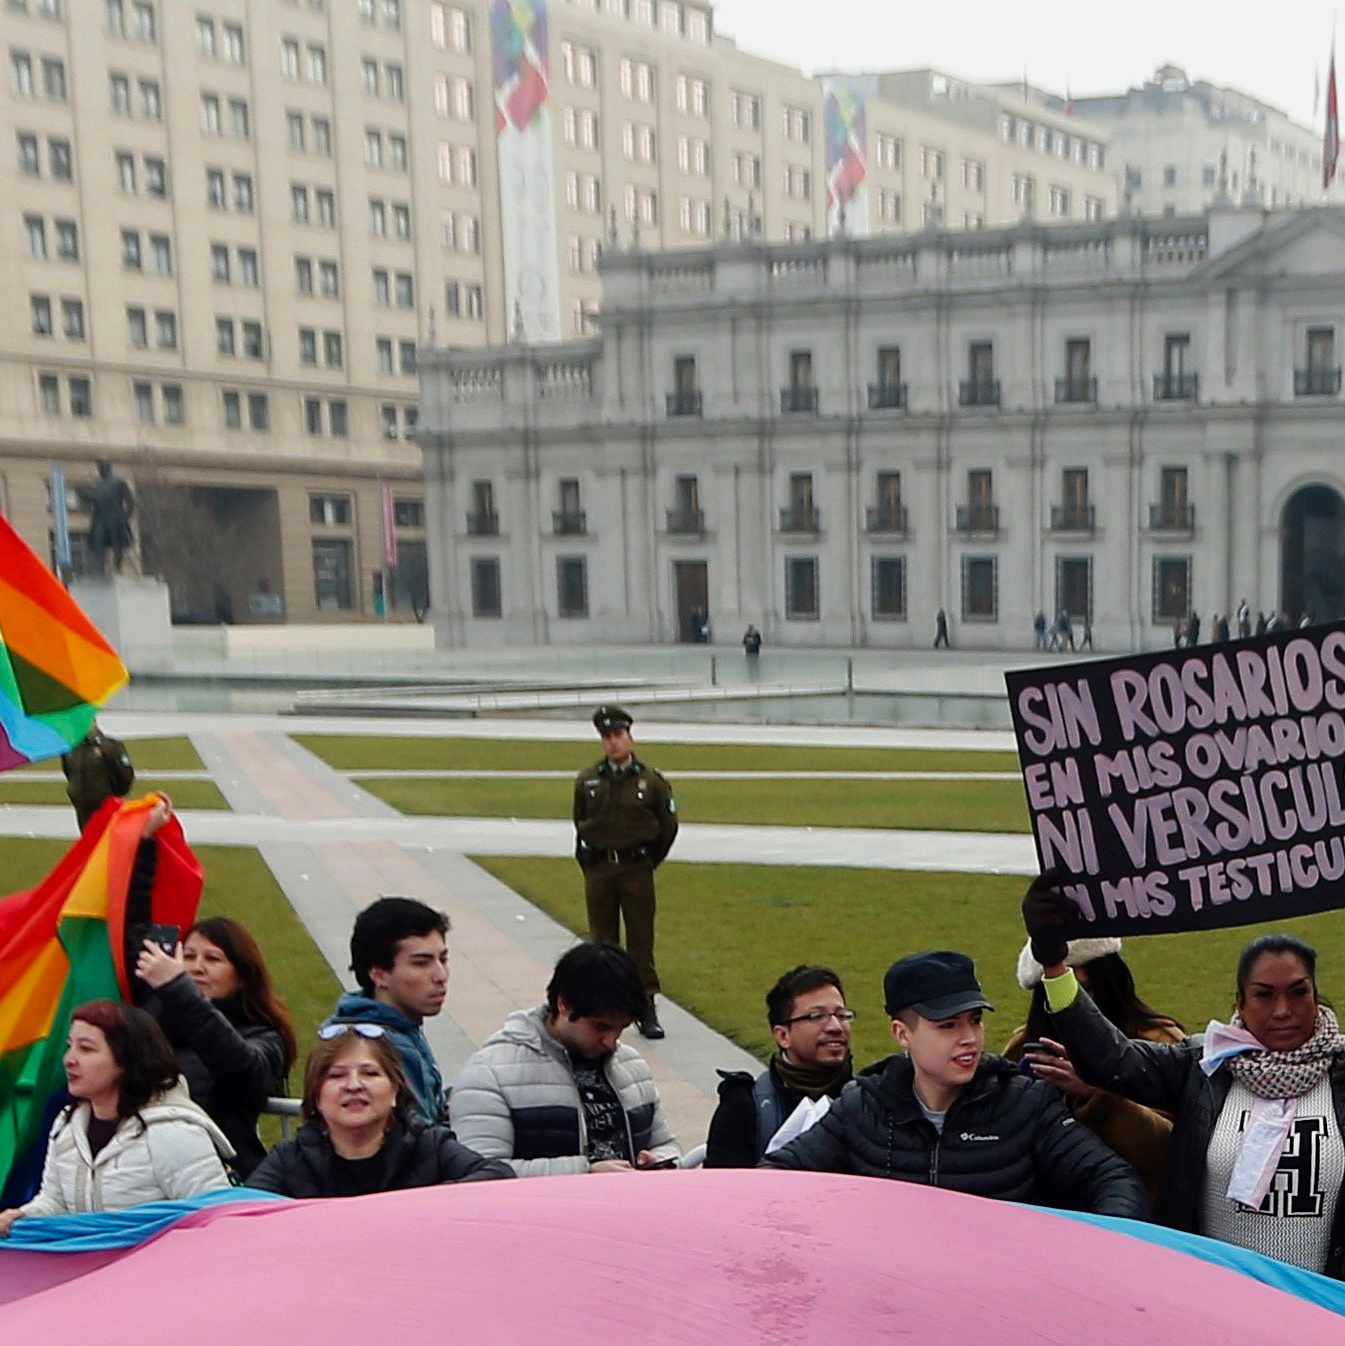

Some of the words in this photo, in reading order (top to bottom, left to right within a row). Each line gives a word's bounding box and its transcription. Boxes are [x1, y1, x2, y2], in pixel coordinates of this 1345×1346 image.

[1019, 679, 1101, 756] SIN
[1024, 757, 1084, 811] EN
[1094, 740, 1182, 798] MIS
[1037, 808, 1099, 875] NI
[1101, 871, 1176, 919] MIS
